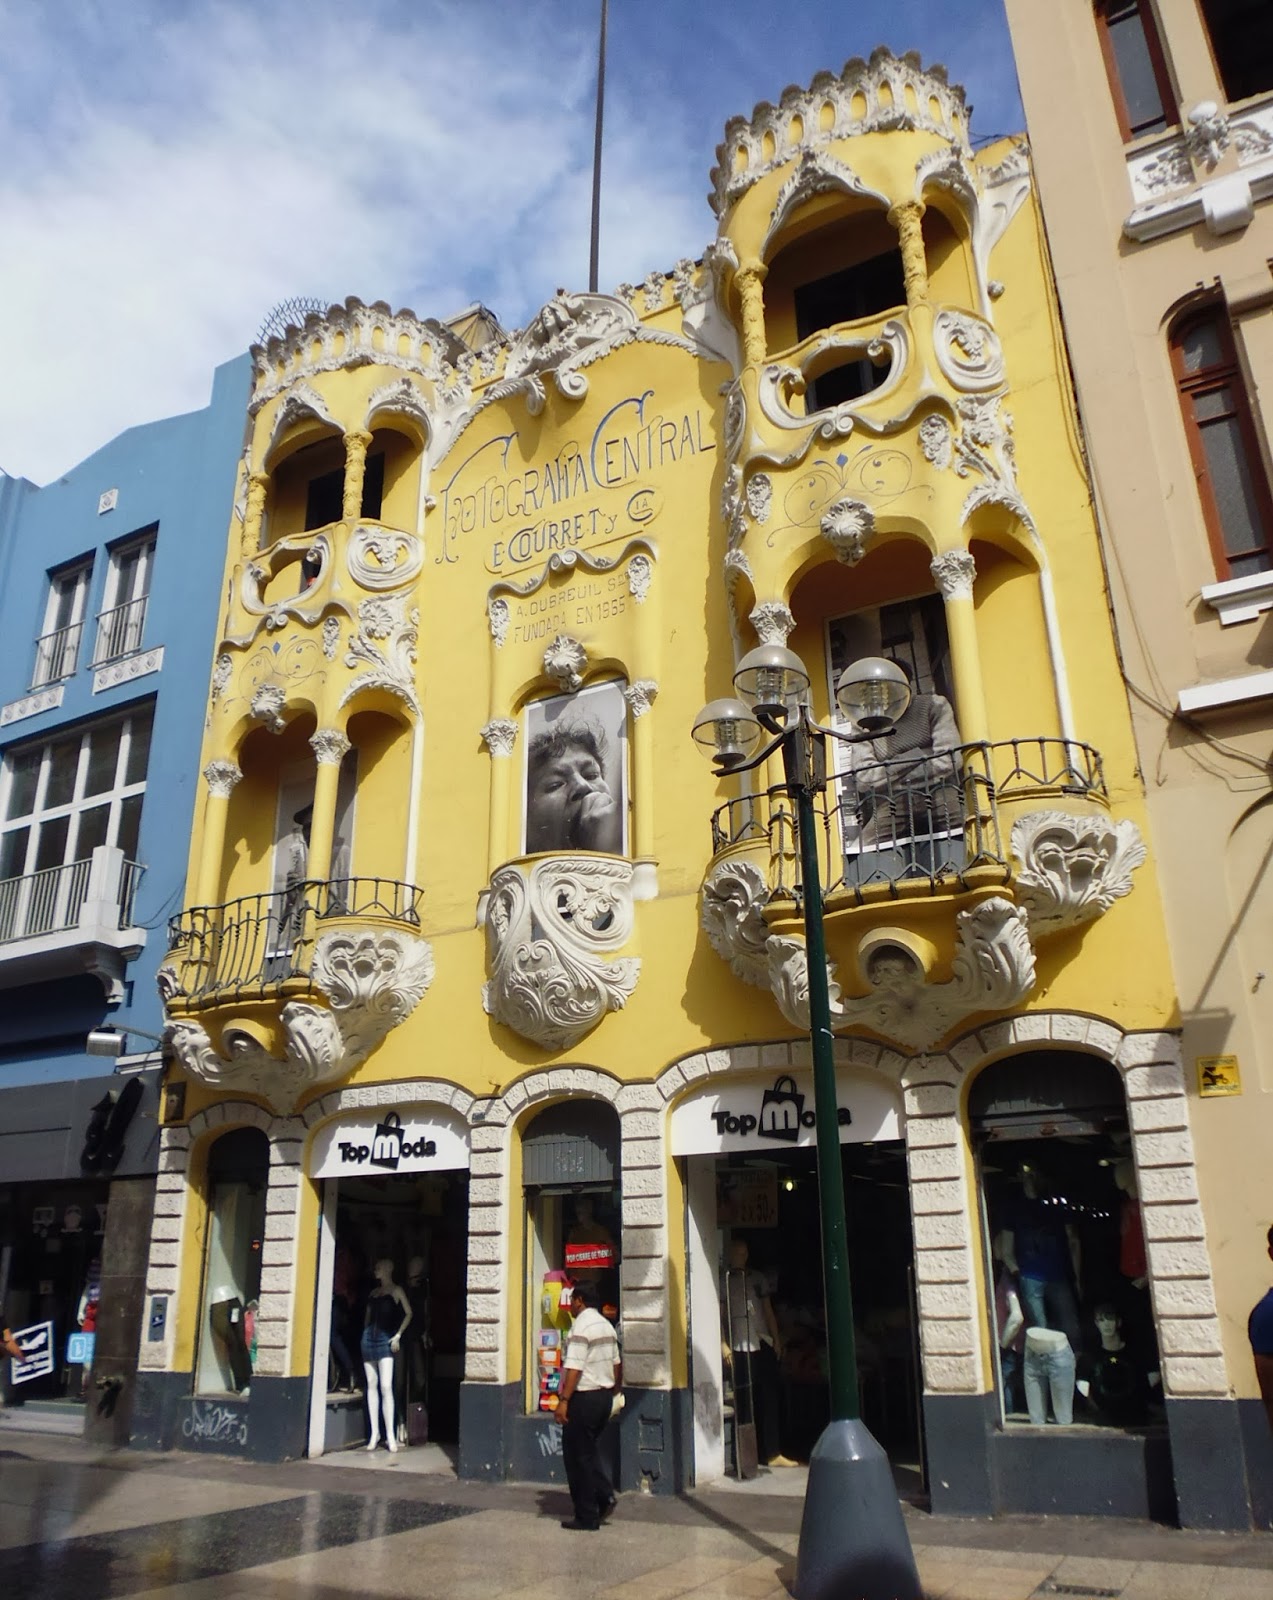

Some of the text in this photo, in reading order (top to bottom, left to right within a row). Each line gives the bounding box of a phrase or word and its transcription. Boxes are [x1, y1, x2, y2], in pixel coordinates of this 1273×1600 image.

[590, 389, 716, 489] CENTRAL
[508, 508, 606, 563] COURRET
[514, 611, 567, 644] FUNDADA
[576, 605, 593, 625] EN
[711, 1110, 757, 1136] Top
[338, 1141, 370, 1164] Top
